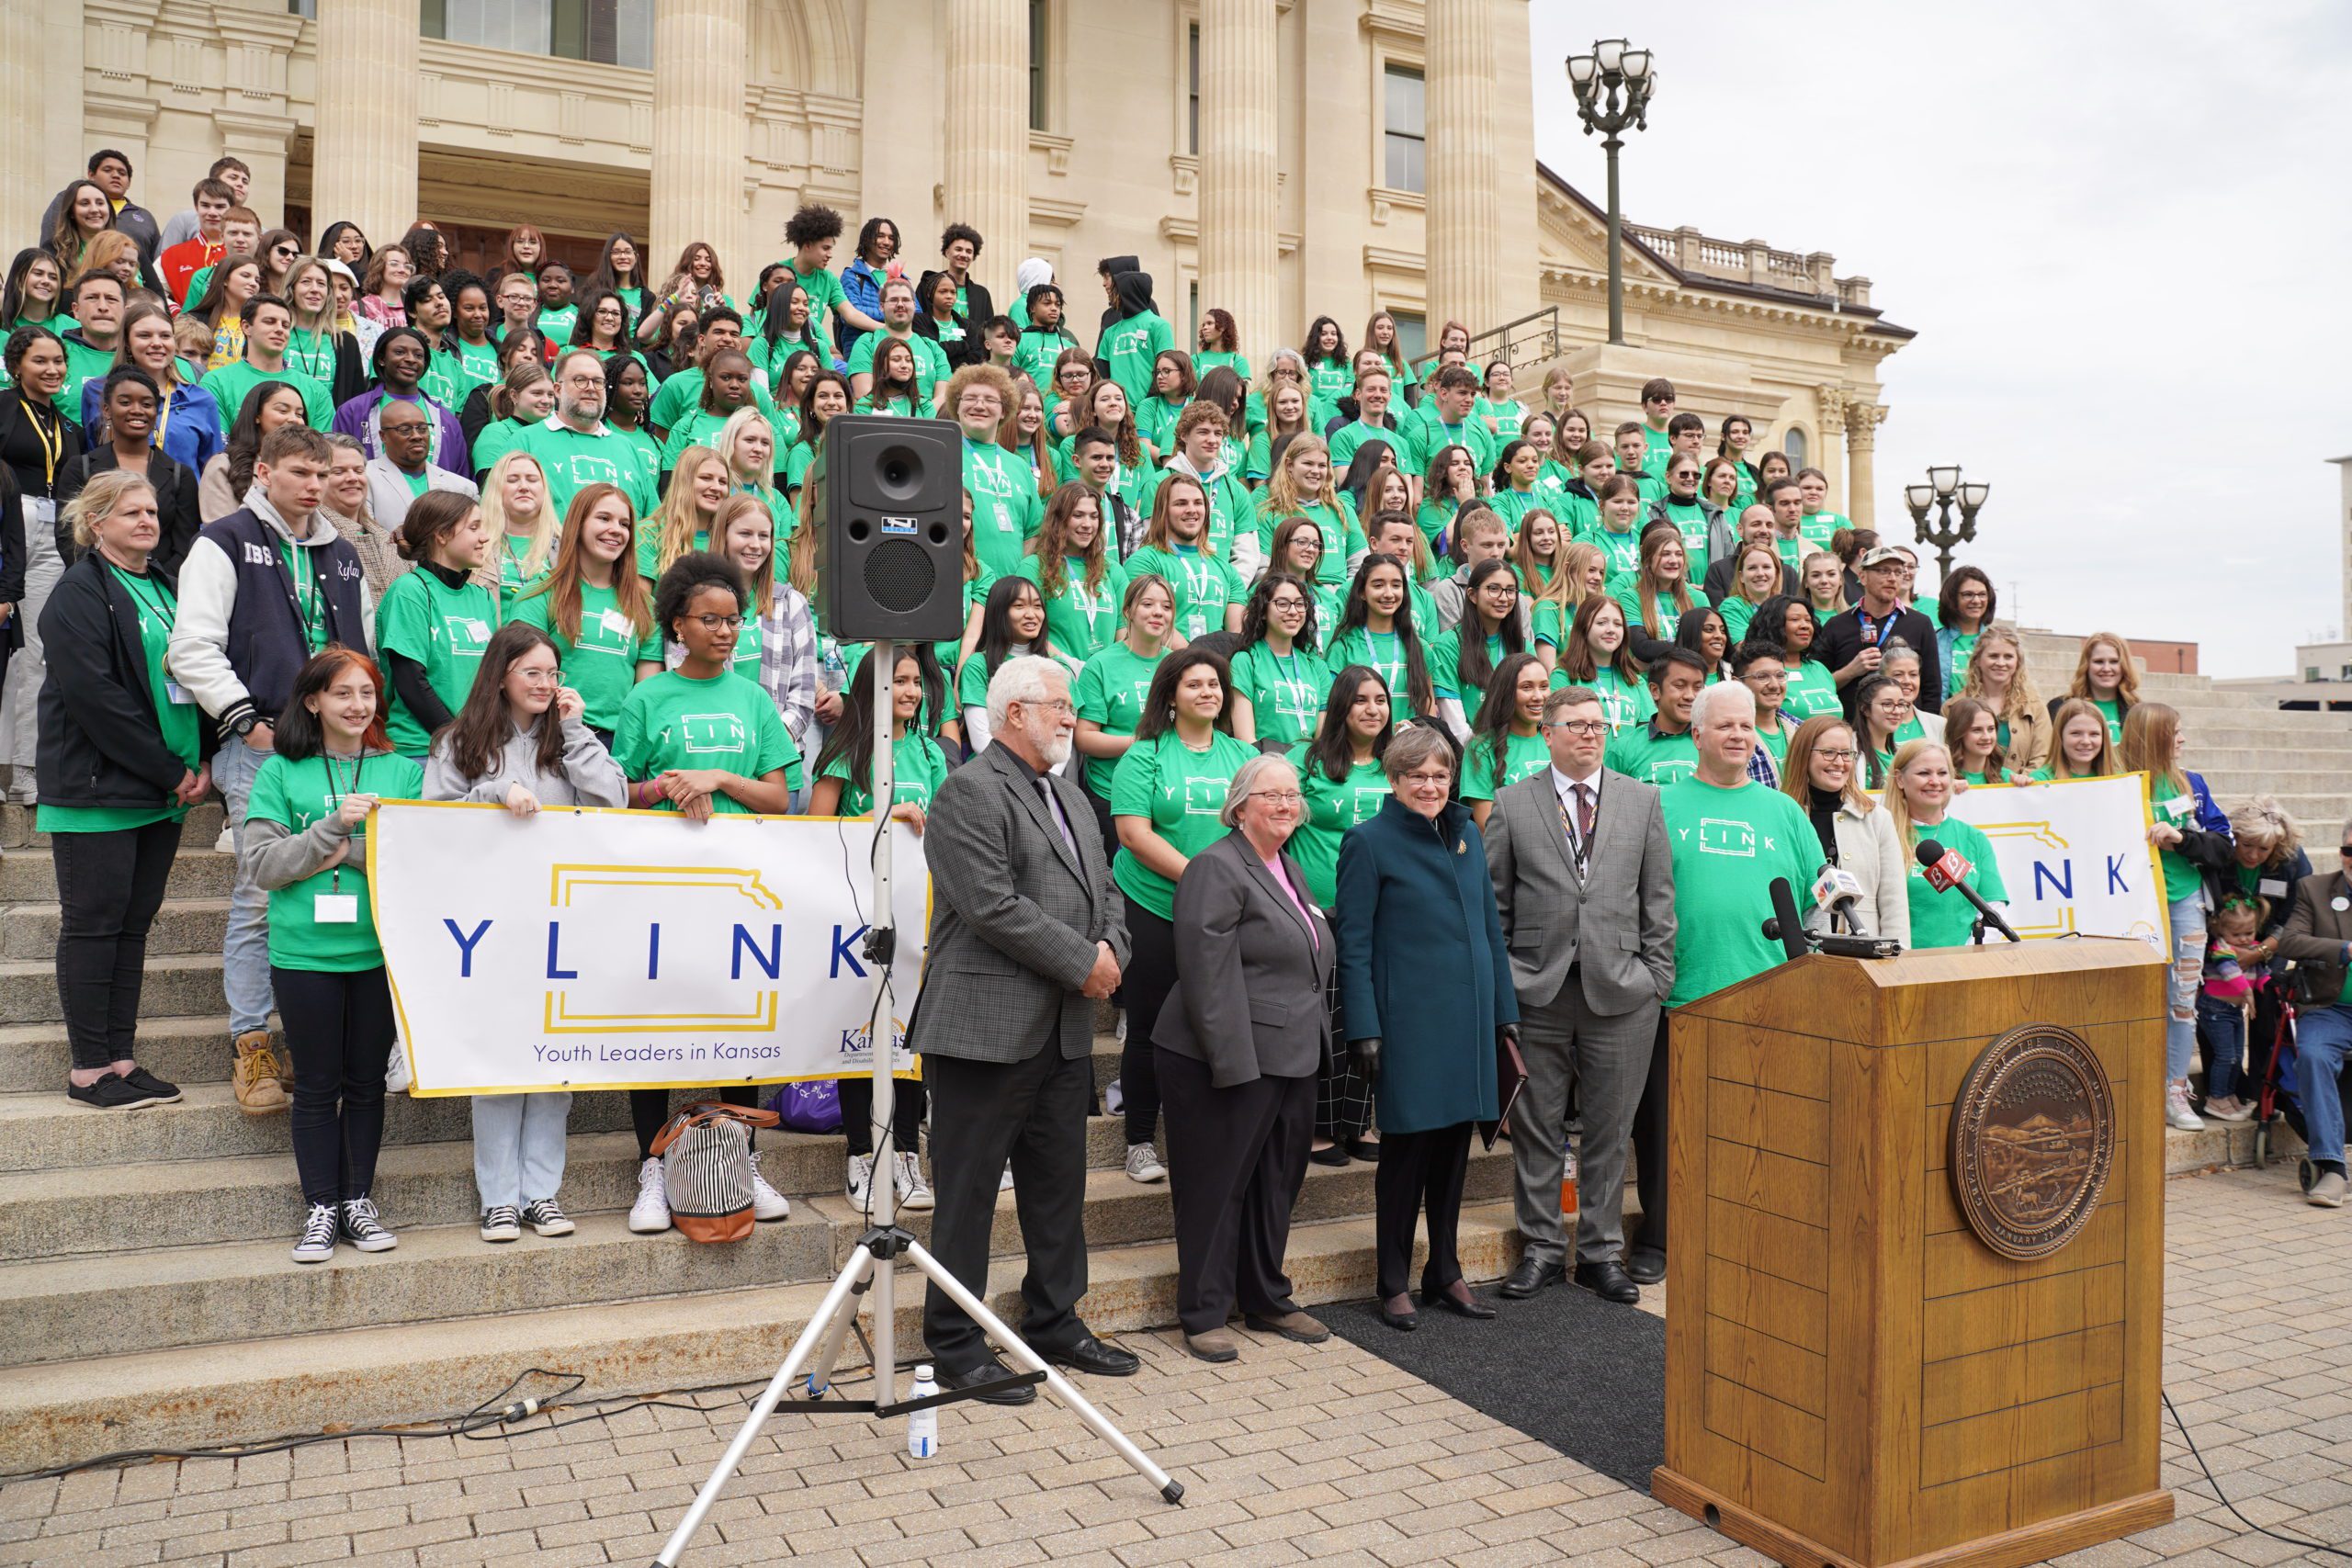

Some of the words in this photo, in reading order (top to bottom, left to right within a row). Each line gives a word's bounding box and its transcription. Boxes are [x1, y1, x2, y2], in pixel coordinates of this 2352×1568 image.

[533, 1043, 593, 1062] Youth
[600, 1043, 684, 1062] Leaders
[690, 1043, 706, 1060] in
[714, 1042, 781, 1060] Kansas
[2018, 1037, 2042, 1053] THE
